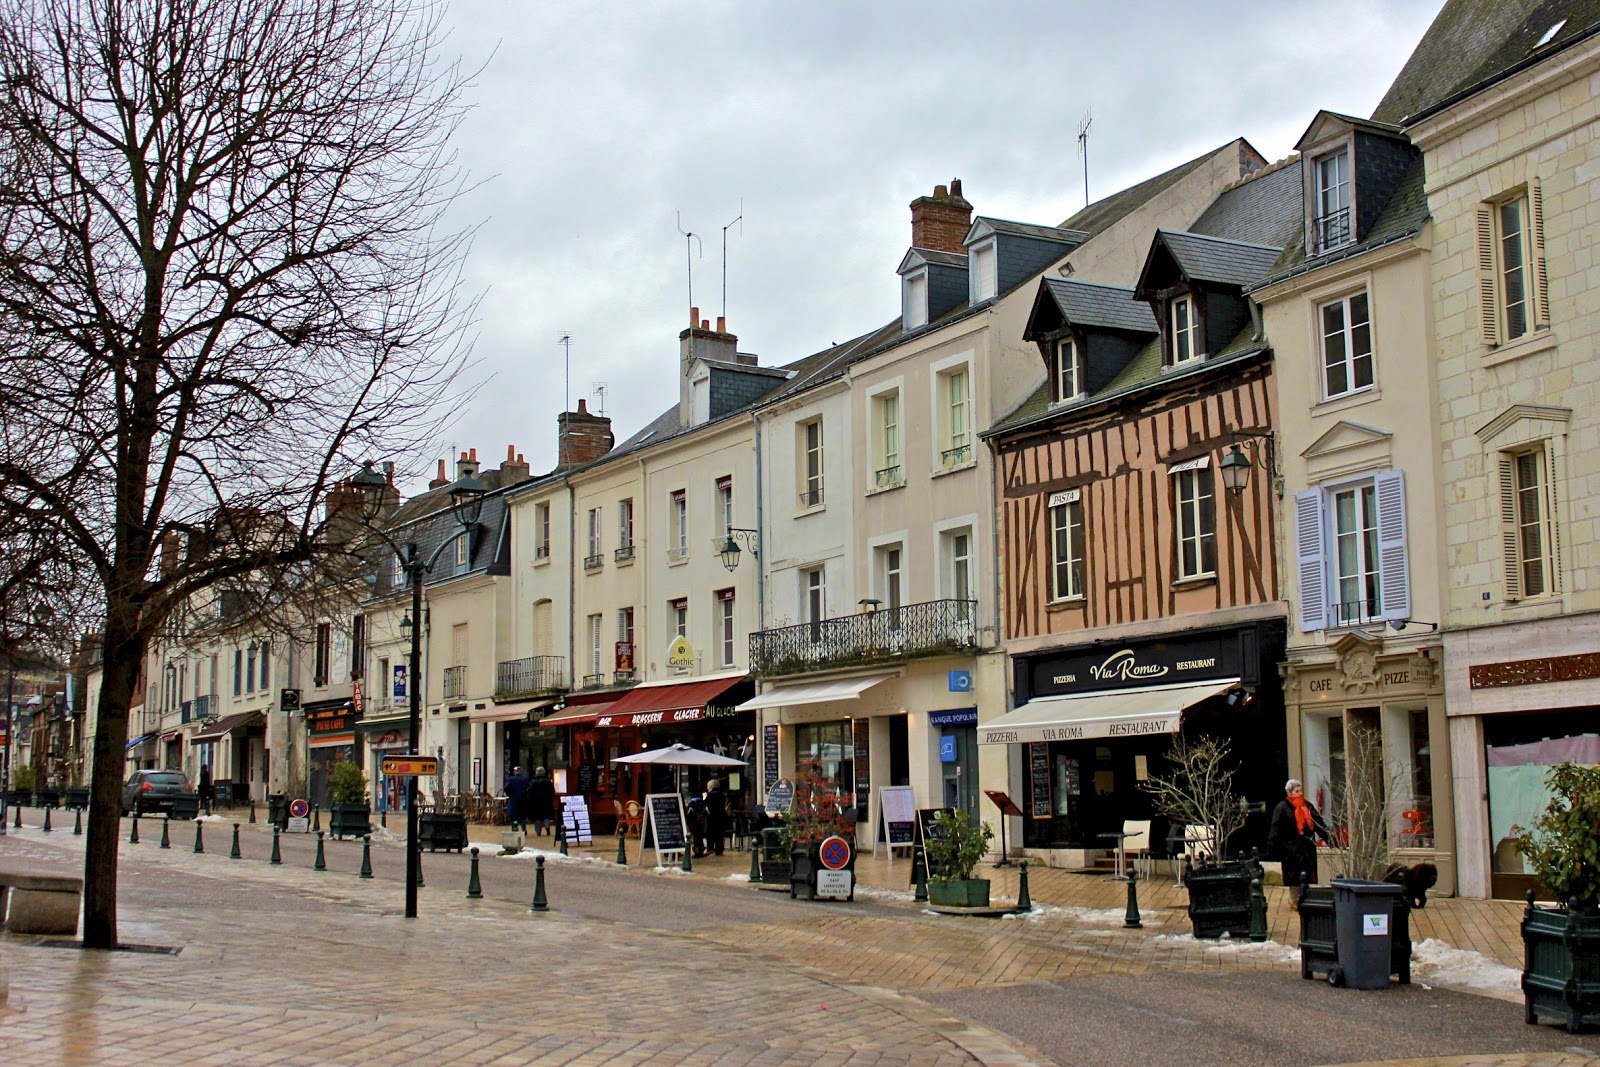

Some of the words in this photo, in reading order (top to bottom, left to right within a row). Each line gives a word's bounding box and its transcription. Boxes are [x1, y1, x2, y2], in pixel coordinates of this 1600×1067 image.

[1175, 460, 1199, 471] PIZZA
[1054, 492, 1073, 504] PASTA
[669, 656, 694, 666] Gothic
[1053, 674, 1076, 684] PIZZERIA
[1117, 657, 1169, 682] Roma
[1176, 658, 1215, 671] RESTAURANT
[1310, 678, 1332, 692] CAFE
[354, 683, 362, 711] TABAC
[598, 717, 612, 726] BAR
[632, 712, 664, 724] BRASSERIE
[674, 709, 700, 721] GLACIER
[931, 715, 952, 723] BANQUE
[986, 731, 1019, 743] PIZZERIA
[1043, 729, 1056, 740] VIA
[1059, 727, 1083, 739] ROMA
[1109, 720, 1168, 736] RESTAURANT
